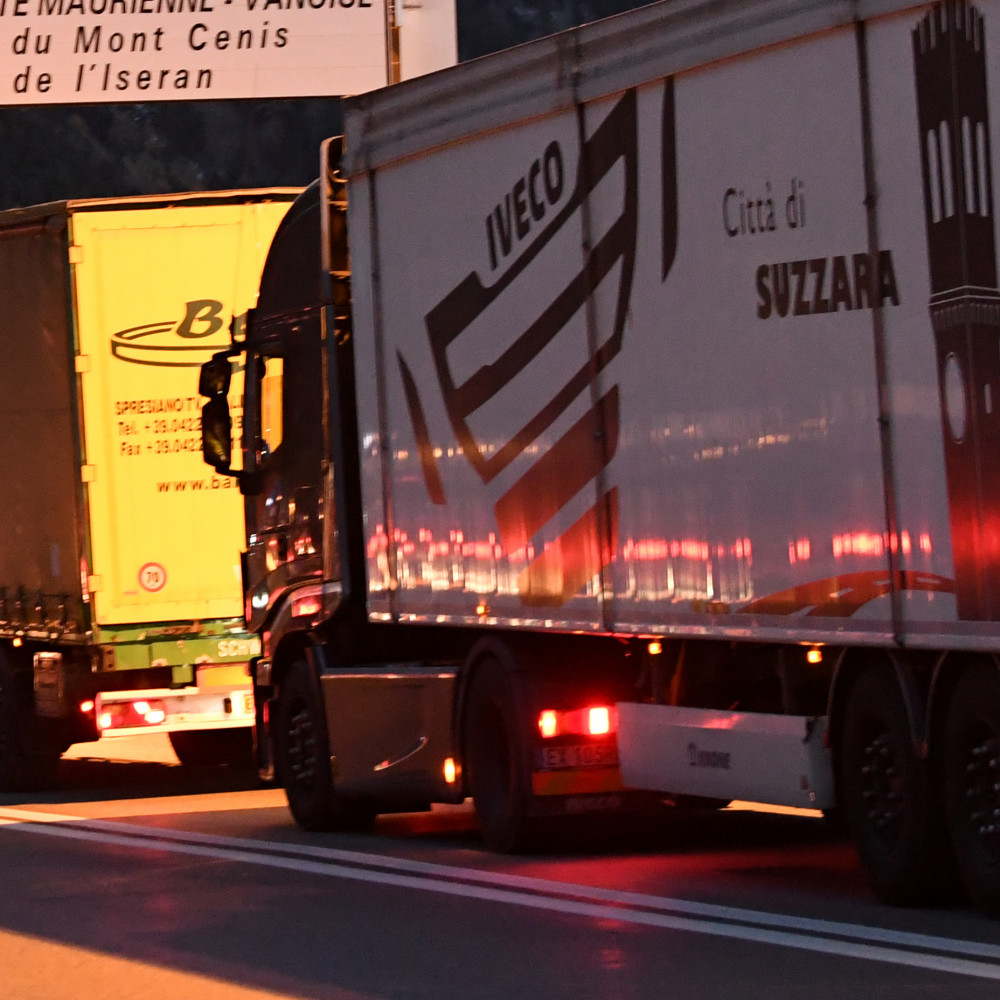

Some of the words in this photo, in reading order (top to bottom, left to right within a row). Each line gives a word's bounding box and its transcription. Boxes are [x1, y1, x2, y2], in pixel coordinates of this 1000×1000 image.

[12, 27, 52, 56] du
[74, 25, 164, 54] Mont
[188, 22, 288, 51] Cenis
[13, 65, 52, 94] de
[486, 140, 565, 272] IVECO
[722, 181, 776, 238] Città
[786, 176, 806, 229] di
[756, 249, 900, 320] SUZZARA
[146, 571, 159, 583] 70
